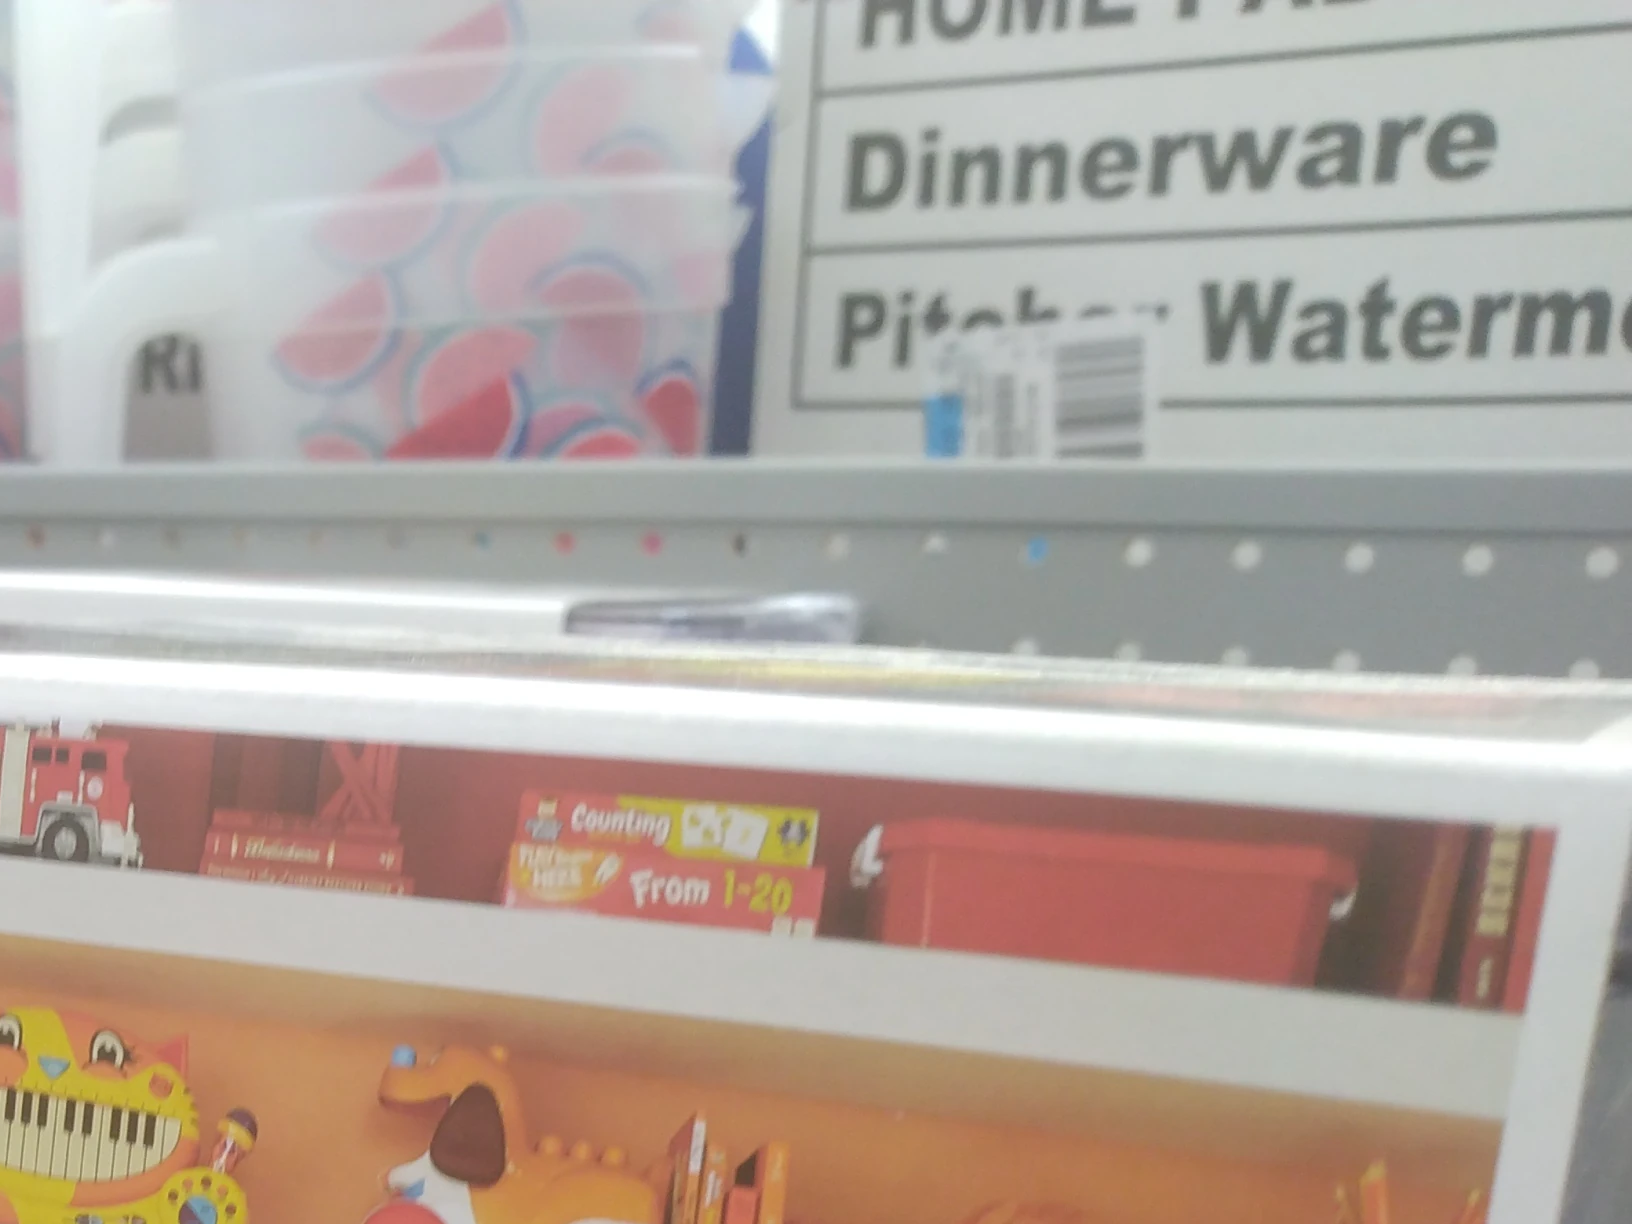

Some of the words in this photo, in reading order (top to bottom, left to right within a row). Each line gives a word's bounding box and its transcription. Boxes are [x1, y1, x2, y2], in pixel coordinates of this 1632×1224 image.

[841, 106, 1500, 215] Dinnerware
[1199, 276, 1632, 367] Waterm
[570, 802, 672, 848] Counting
[629, 867, 711, 909] From
[723, 867, 794, 916] 1-20
